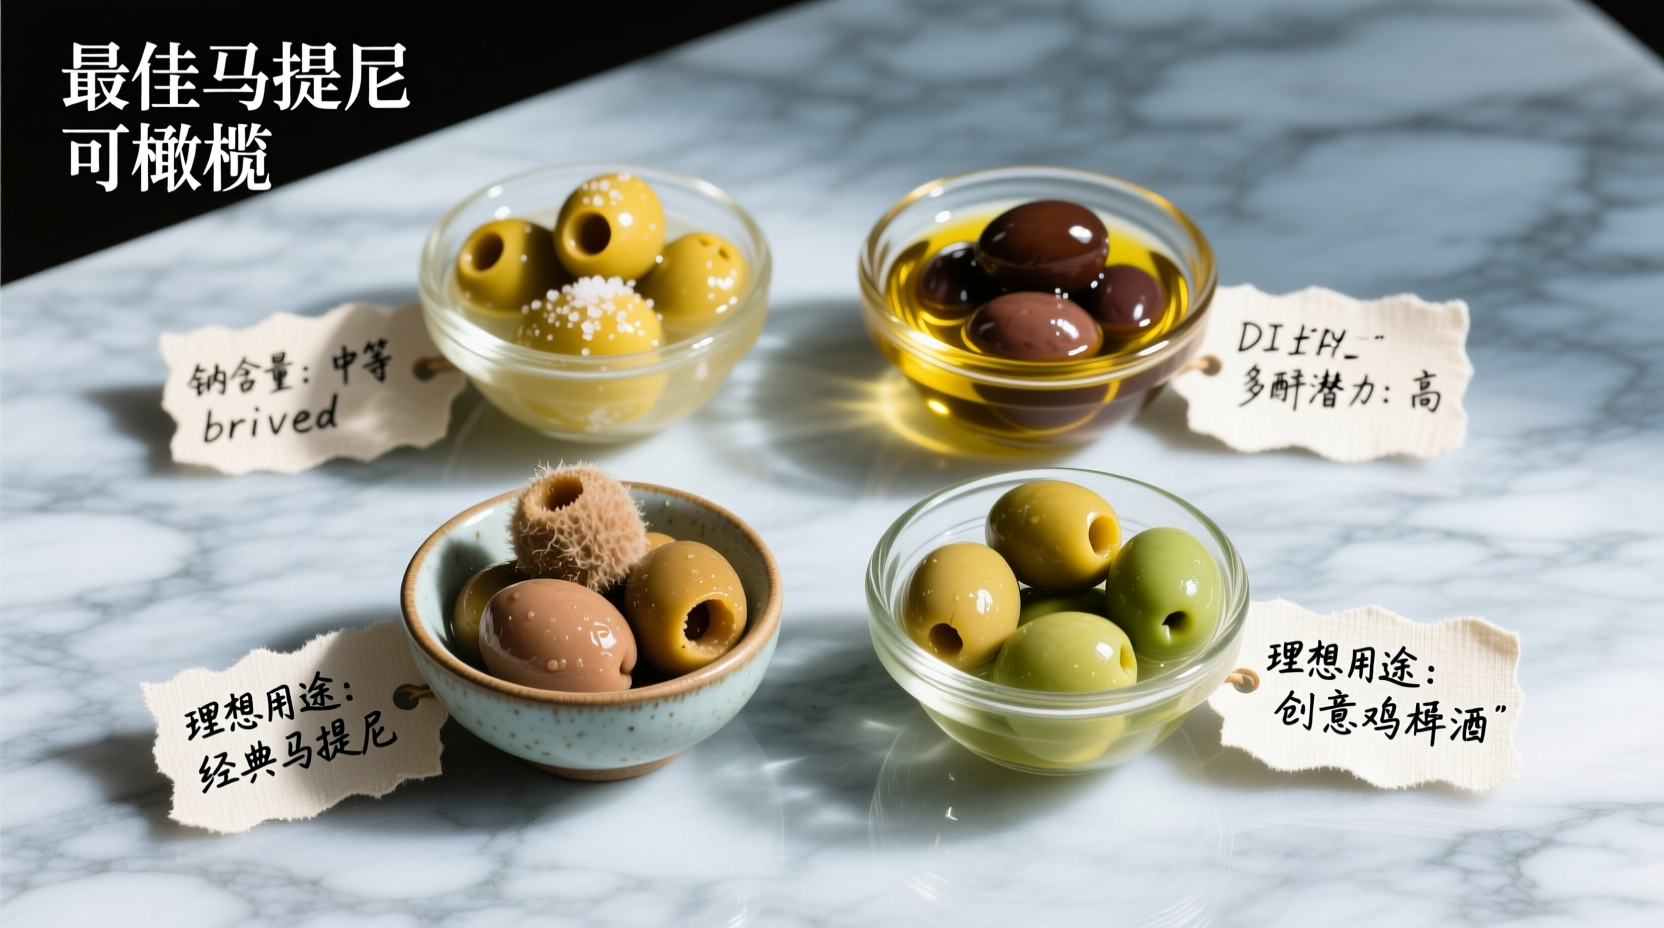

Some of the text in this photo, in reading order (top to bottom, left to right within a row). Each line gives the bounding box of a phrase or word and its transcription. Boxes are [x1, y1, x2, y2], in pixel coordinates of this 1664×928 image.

[203, 393, 339, 443] brived
[1266, 639, 1435, 688] 理想用途：
[184, 671, 354, 741] 理想用途：
[199, 710, 398, 794] 经典马提尼
